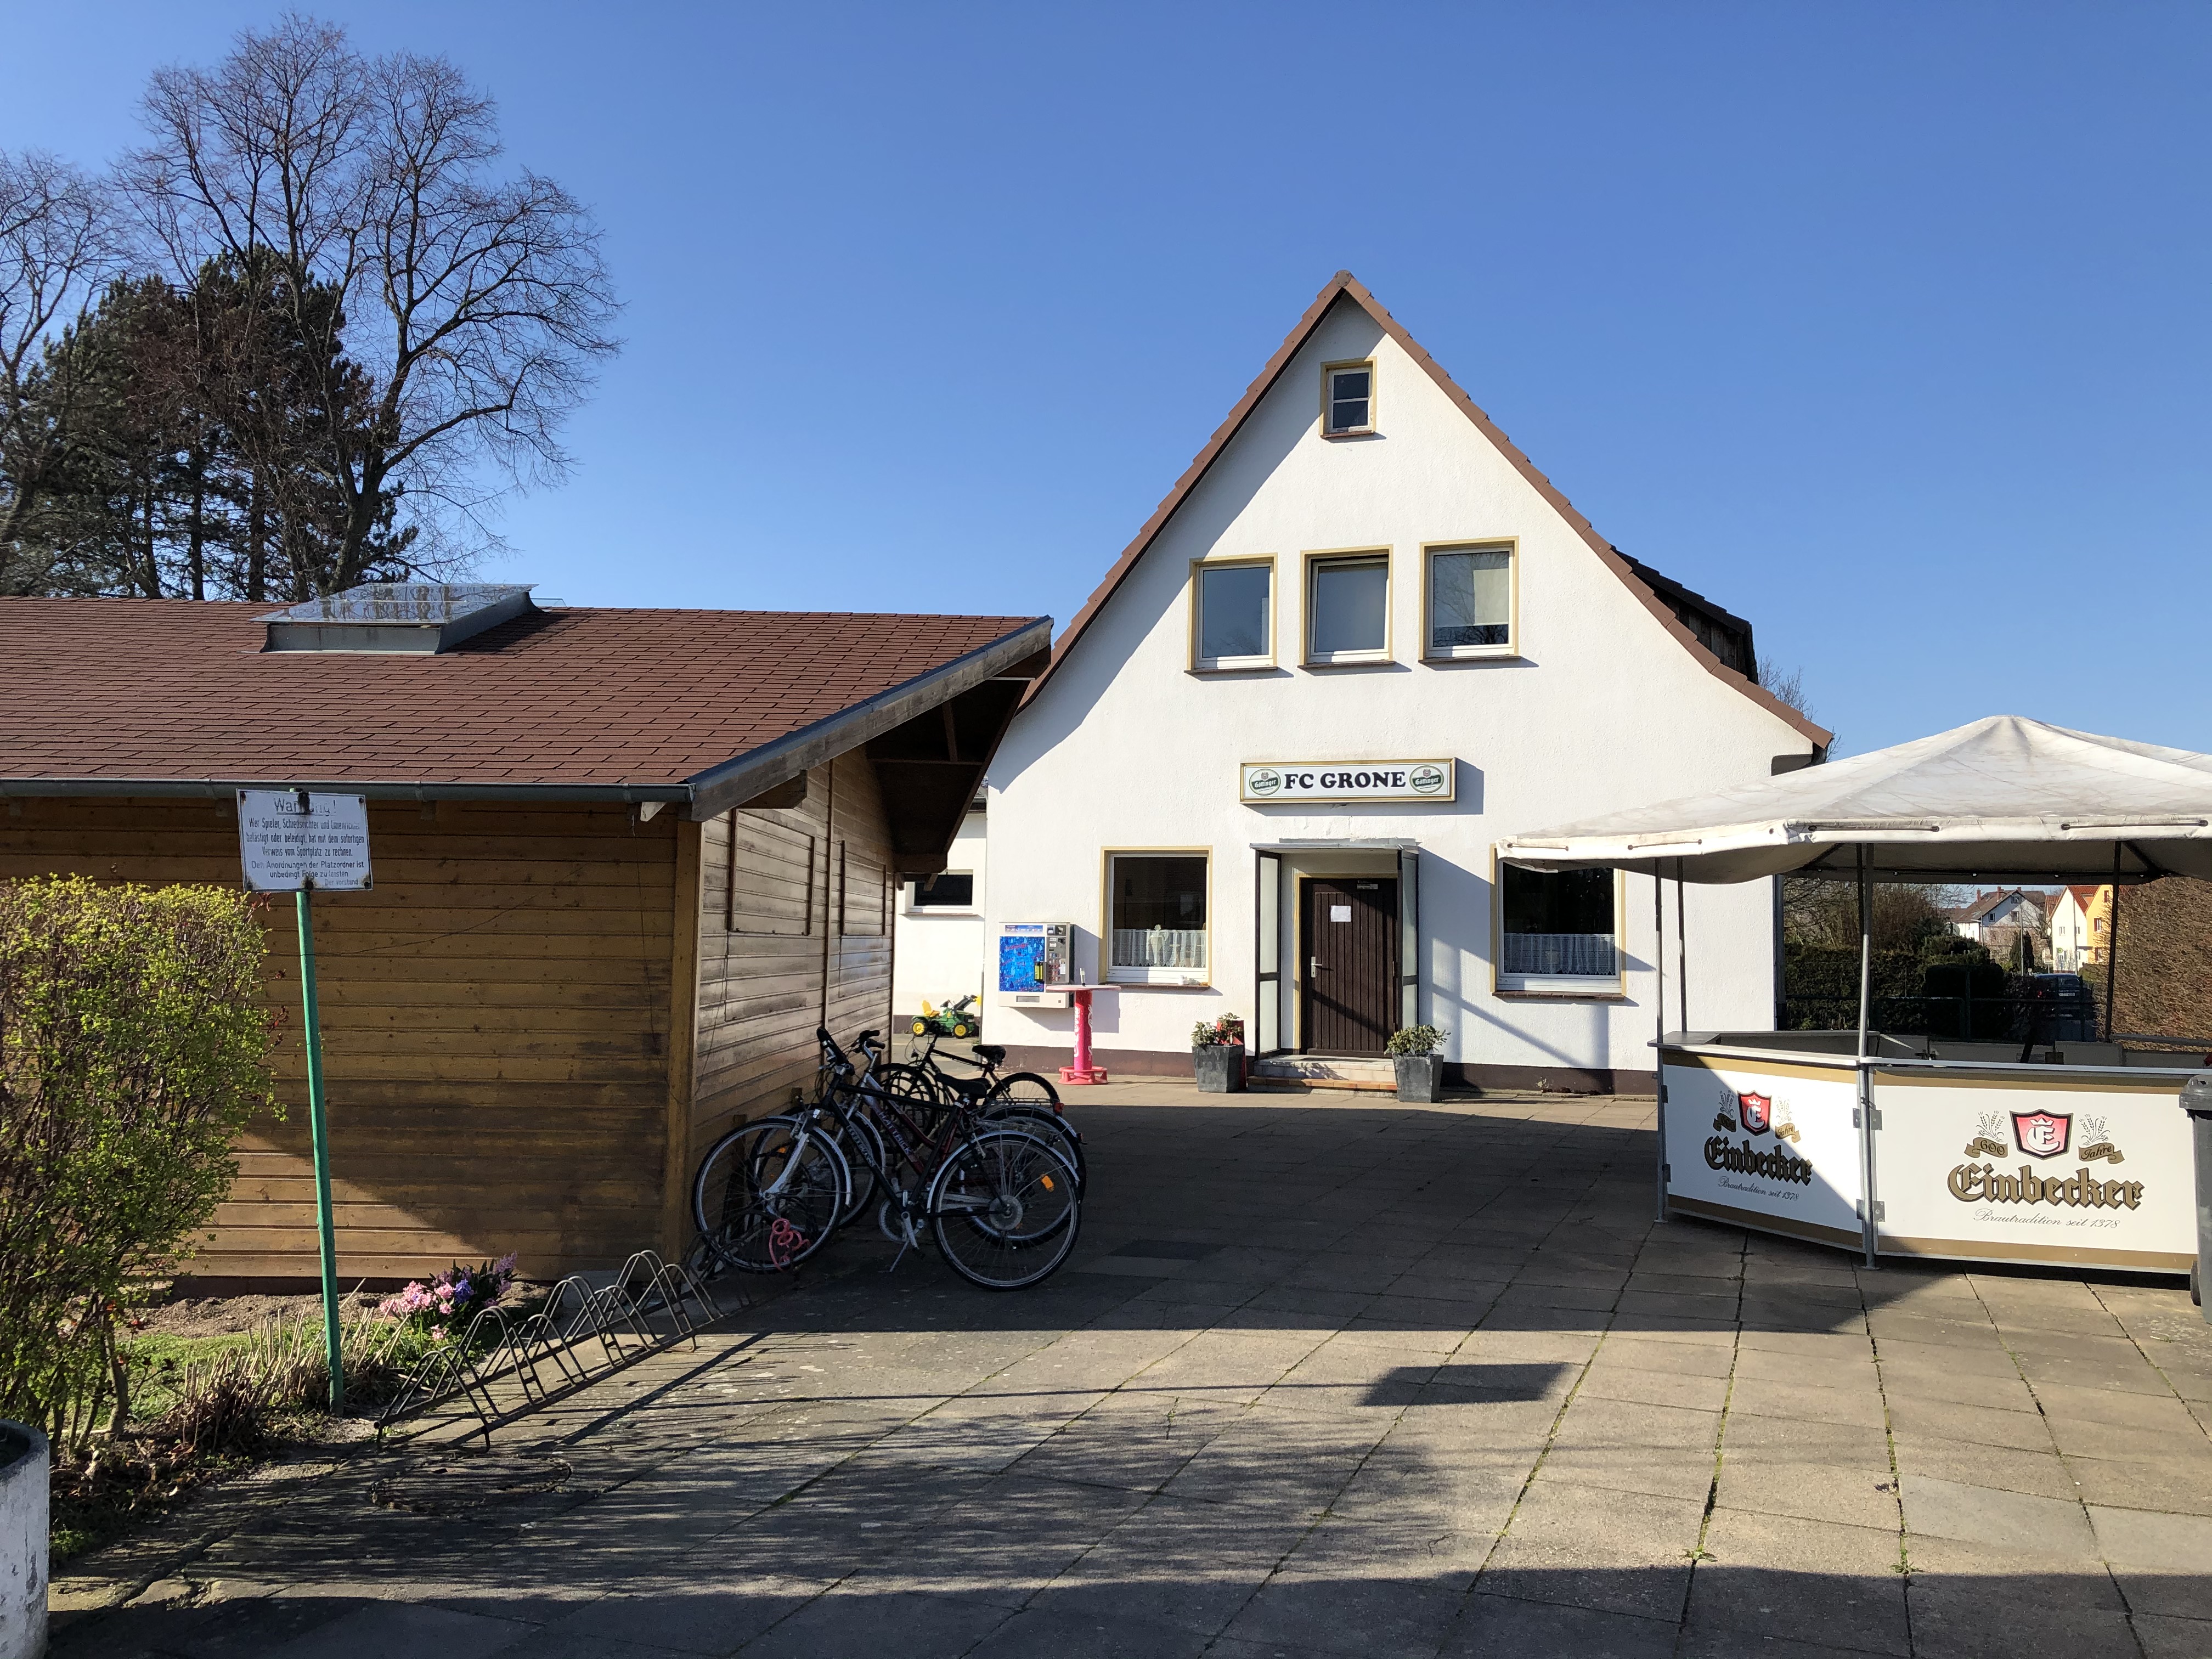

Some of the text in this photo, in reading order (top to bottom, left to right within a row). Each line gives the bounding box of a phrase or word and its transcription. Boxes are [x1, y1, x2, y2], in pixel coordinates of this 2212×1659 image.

[1284, 771, 1406, 789] FC GRONE
[249, 817, 259, 827] Wer
[262, 817, 281, 830] Spieler,
[283, 818, 318, 830] Schiedsrichter
[271, 833, 281, 842] oder
[285, 833, 307, 845] beleidigt,
[328, 833, 338, 843] dem
[341, 833, 364, 845] sofortigen
[262, 847, 283, 856] Verweis
[297, 846, 322, 858] Sportplatz
[251, 861, 264, 869] Den
[267, 861, 307, 870] Anordnungen
[321, 860, 354, 868] Platzordner
[270, 871, 300, 880] unbedingt
[302, 870, 318, 878] Folge
[1980, 1139, 2112, 1160] 600 Jahre
[1704, 1135, 1813, 1186] Einbecker
[1718, 1176, 1799, 1201] Brautradition seit 1378
[1947, 1163, 2145, 1210] Einbecker
[1973, 1209, 2120, 1228] Brautradition seit 1378
